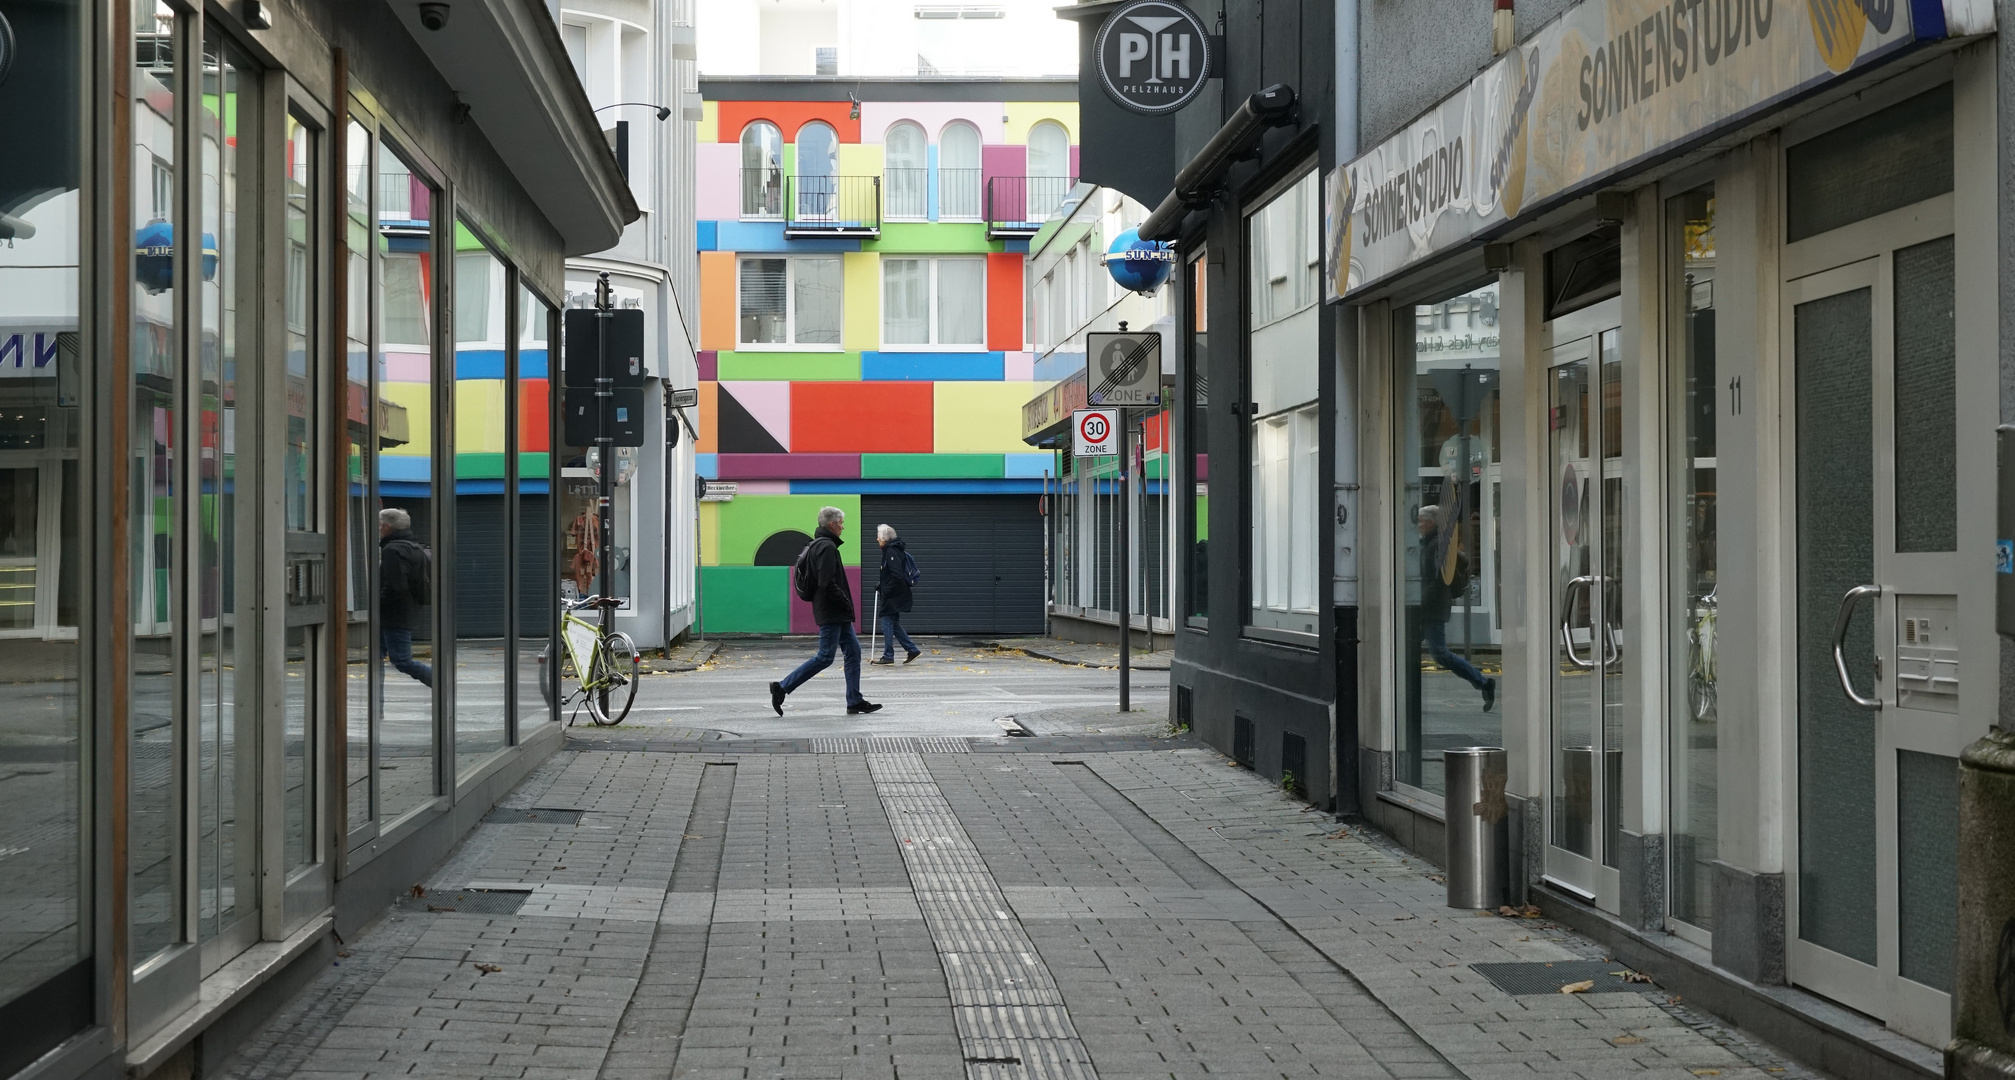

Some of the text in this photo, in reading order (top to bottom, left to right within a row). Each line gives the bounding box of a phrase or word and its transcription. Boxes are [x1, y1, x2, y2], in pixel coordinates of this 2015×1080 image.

[1123, 85, 1184, 94] PELZHAUS
[1362, 136, 1464, 248] SONNENSTUDIO
[1106, 389, 1143, 402] ZONE
[1729, 375, 1741, 416] 11
[1086, 421, 1104, 436] 30
[1084, 445, 1107, 453] ZONE
